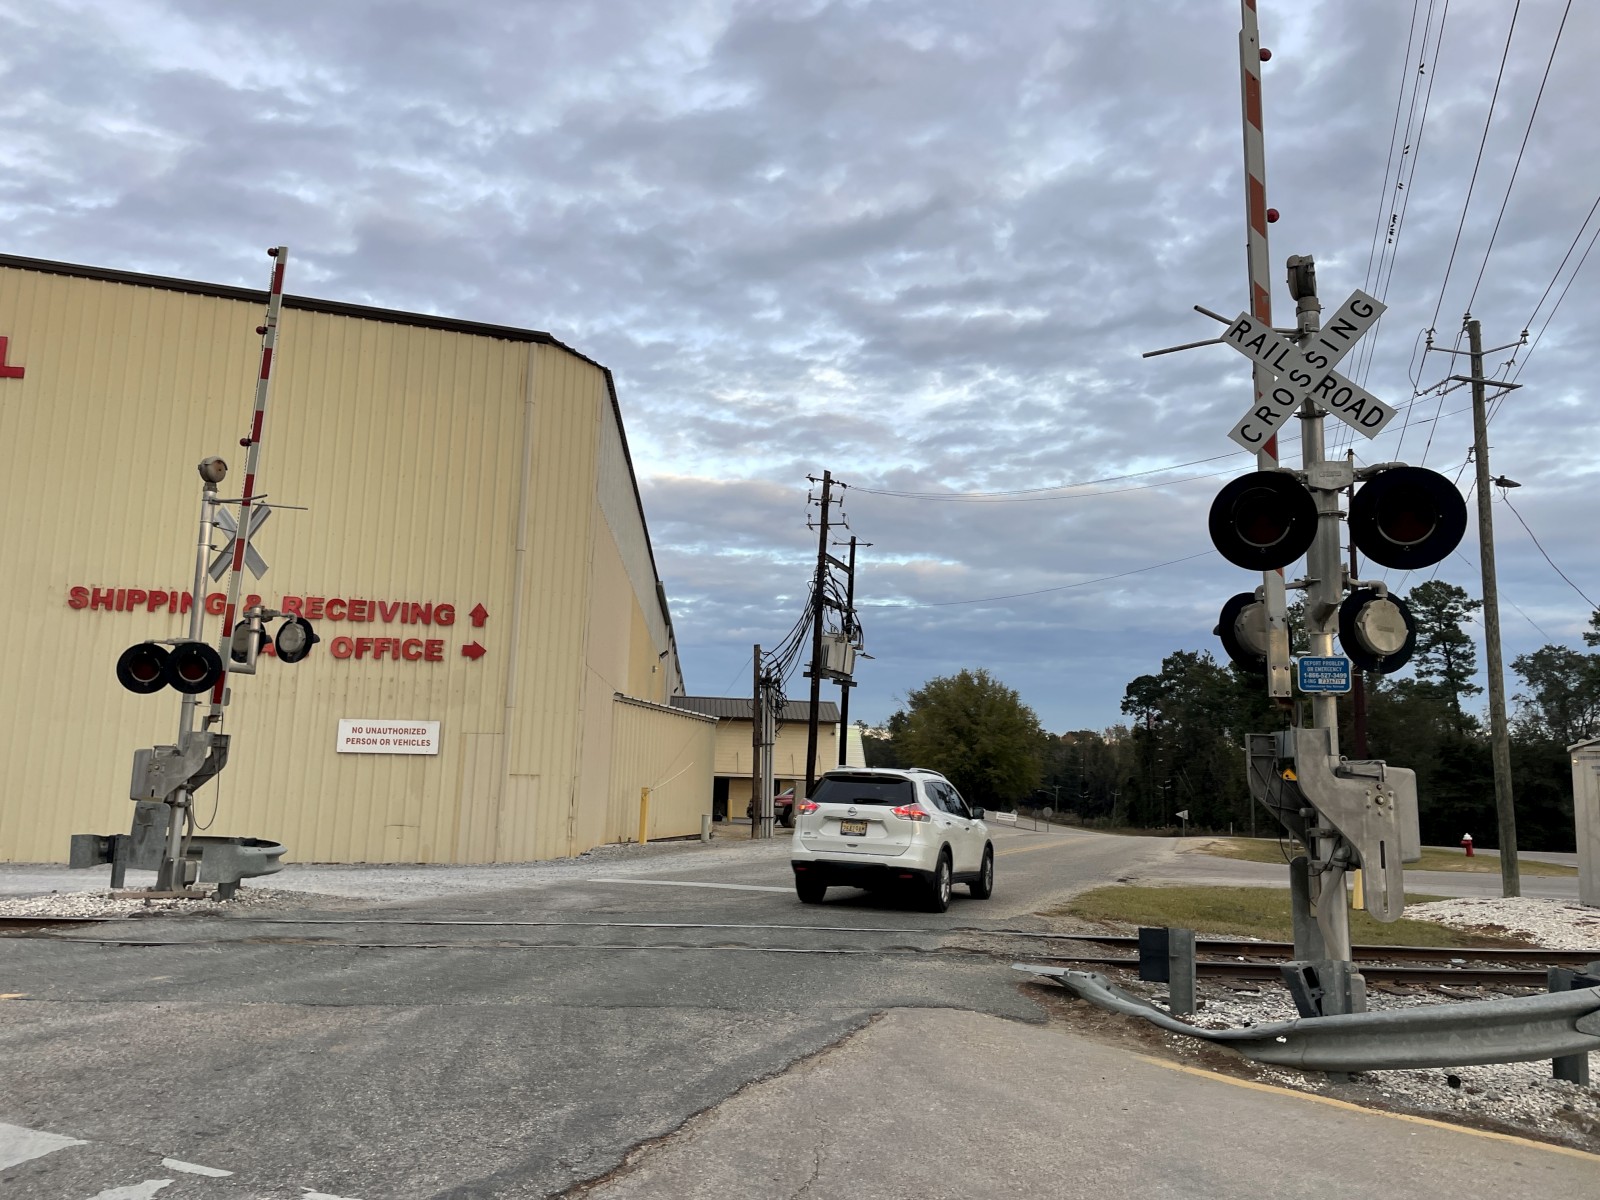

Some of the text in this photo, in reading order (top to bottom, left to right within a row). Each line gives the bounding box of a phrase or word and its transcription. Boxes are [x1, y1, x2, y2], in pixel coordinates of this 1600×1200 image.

[1228, 319, 1384, 428] RAIL ROAD
[1240, 299, 1374, 443] CROSSING
[281, 596, 456, 626] RECEIVING
[330, 636, 444, 662] OFFICE
[345, 737, 431, 747] PERSON OR VEHICLES
[351, 726, 427, 736] NO UNAUTHORIZED
